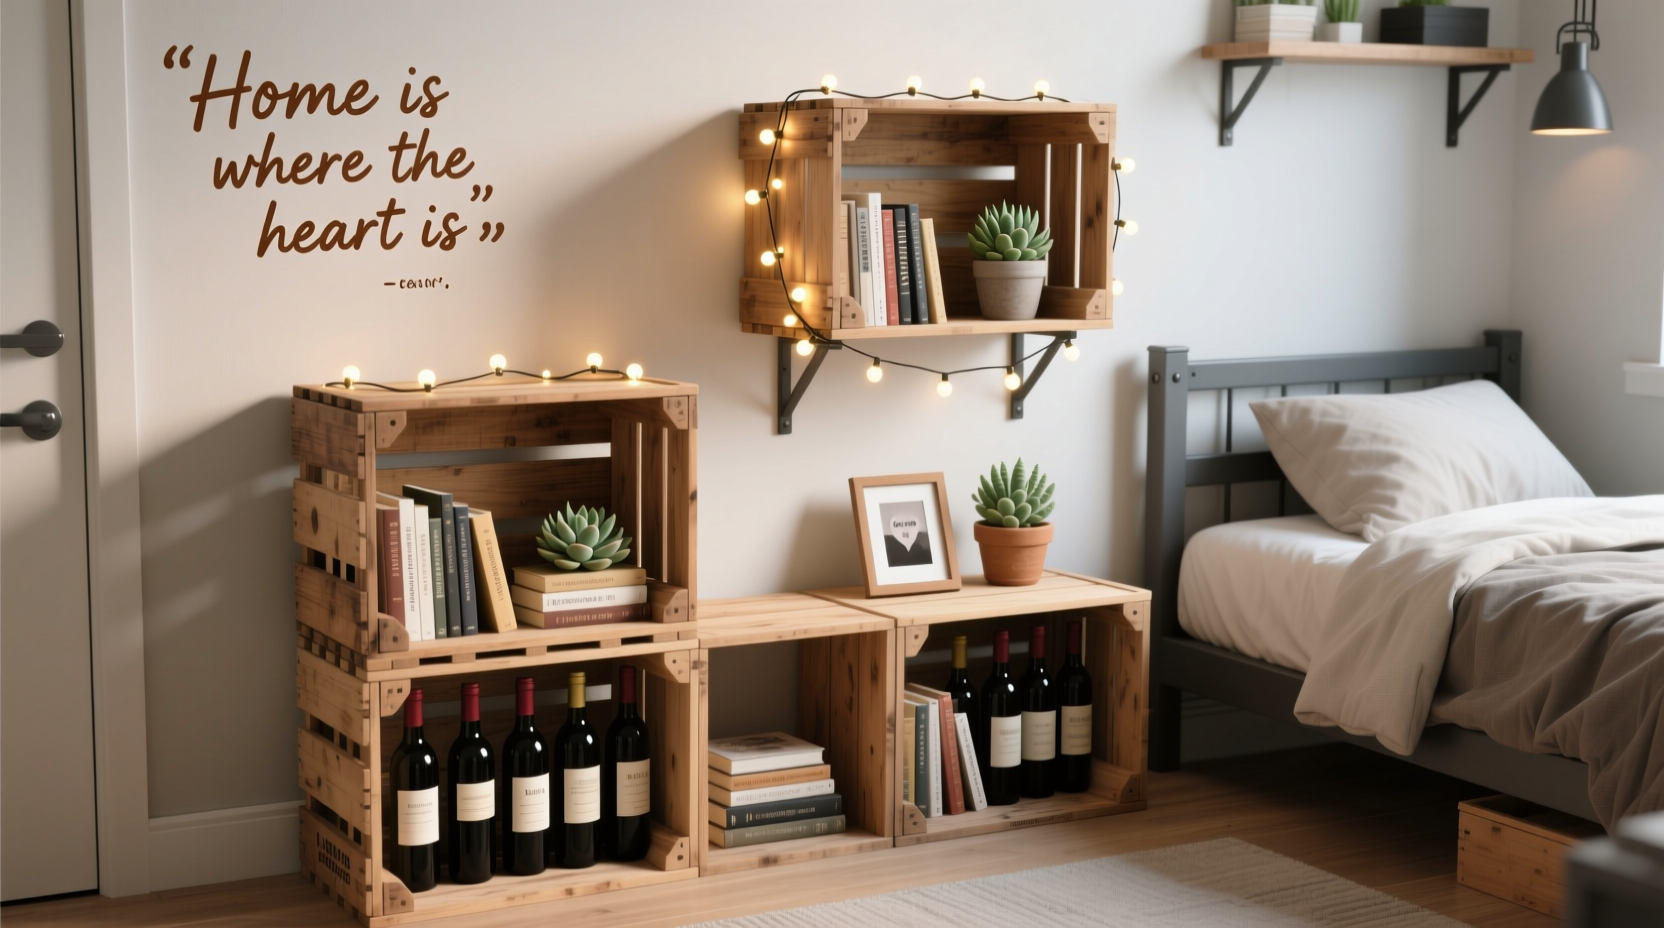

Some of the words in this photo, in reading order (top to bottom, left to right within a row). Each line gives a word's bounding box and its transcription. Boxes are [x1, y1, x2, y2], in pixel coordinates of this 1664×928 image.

[399, 66, 450, 119] is
[213, 131, 373, 190] where
[387, 127, 475, 184] the
[256, 197, 406, 258] heart
